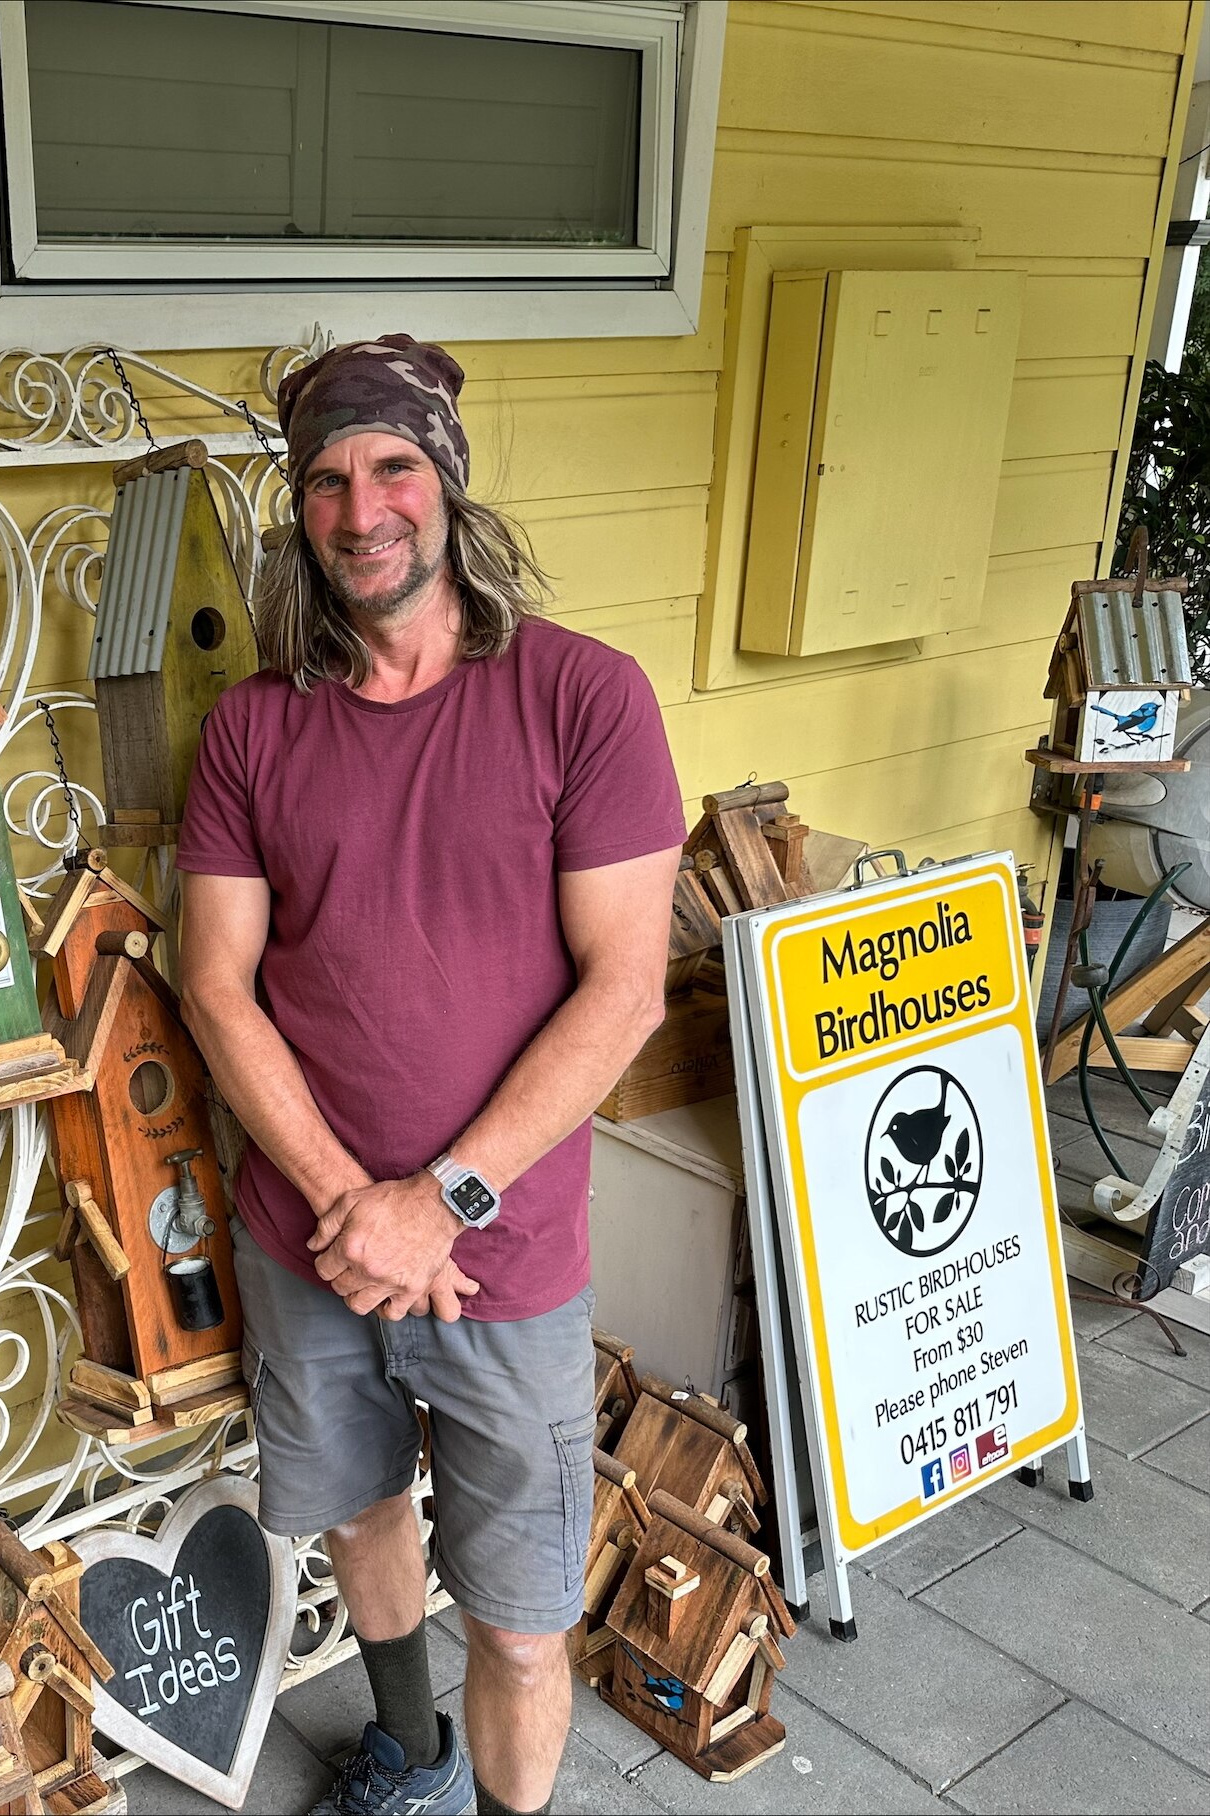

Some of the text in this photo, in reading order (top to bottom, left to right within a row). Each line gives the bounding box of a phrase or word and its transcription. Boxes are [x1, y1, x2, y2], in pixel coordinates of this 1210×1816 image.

[822, 900, 973, 983] Magnolia
[815, 975, 991, 1059] Birdhouses
[855, 1235, 1021, 1327] RUSTIC BIRDHOUSES
[905, 1285, 983, 1340] FOR SALE
[875, 1339, 1029, 1428] Please phone Steven
[913, 1321, 984, 1372] From $30
[901, 1380, 1018, 1465] 0415 811 791
[131, 1574, 212, 1655] Gift
[125, 1636, 240, 1716] Ideas
